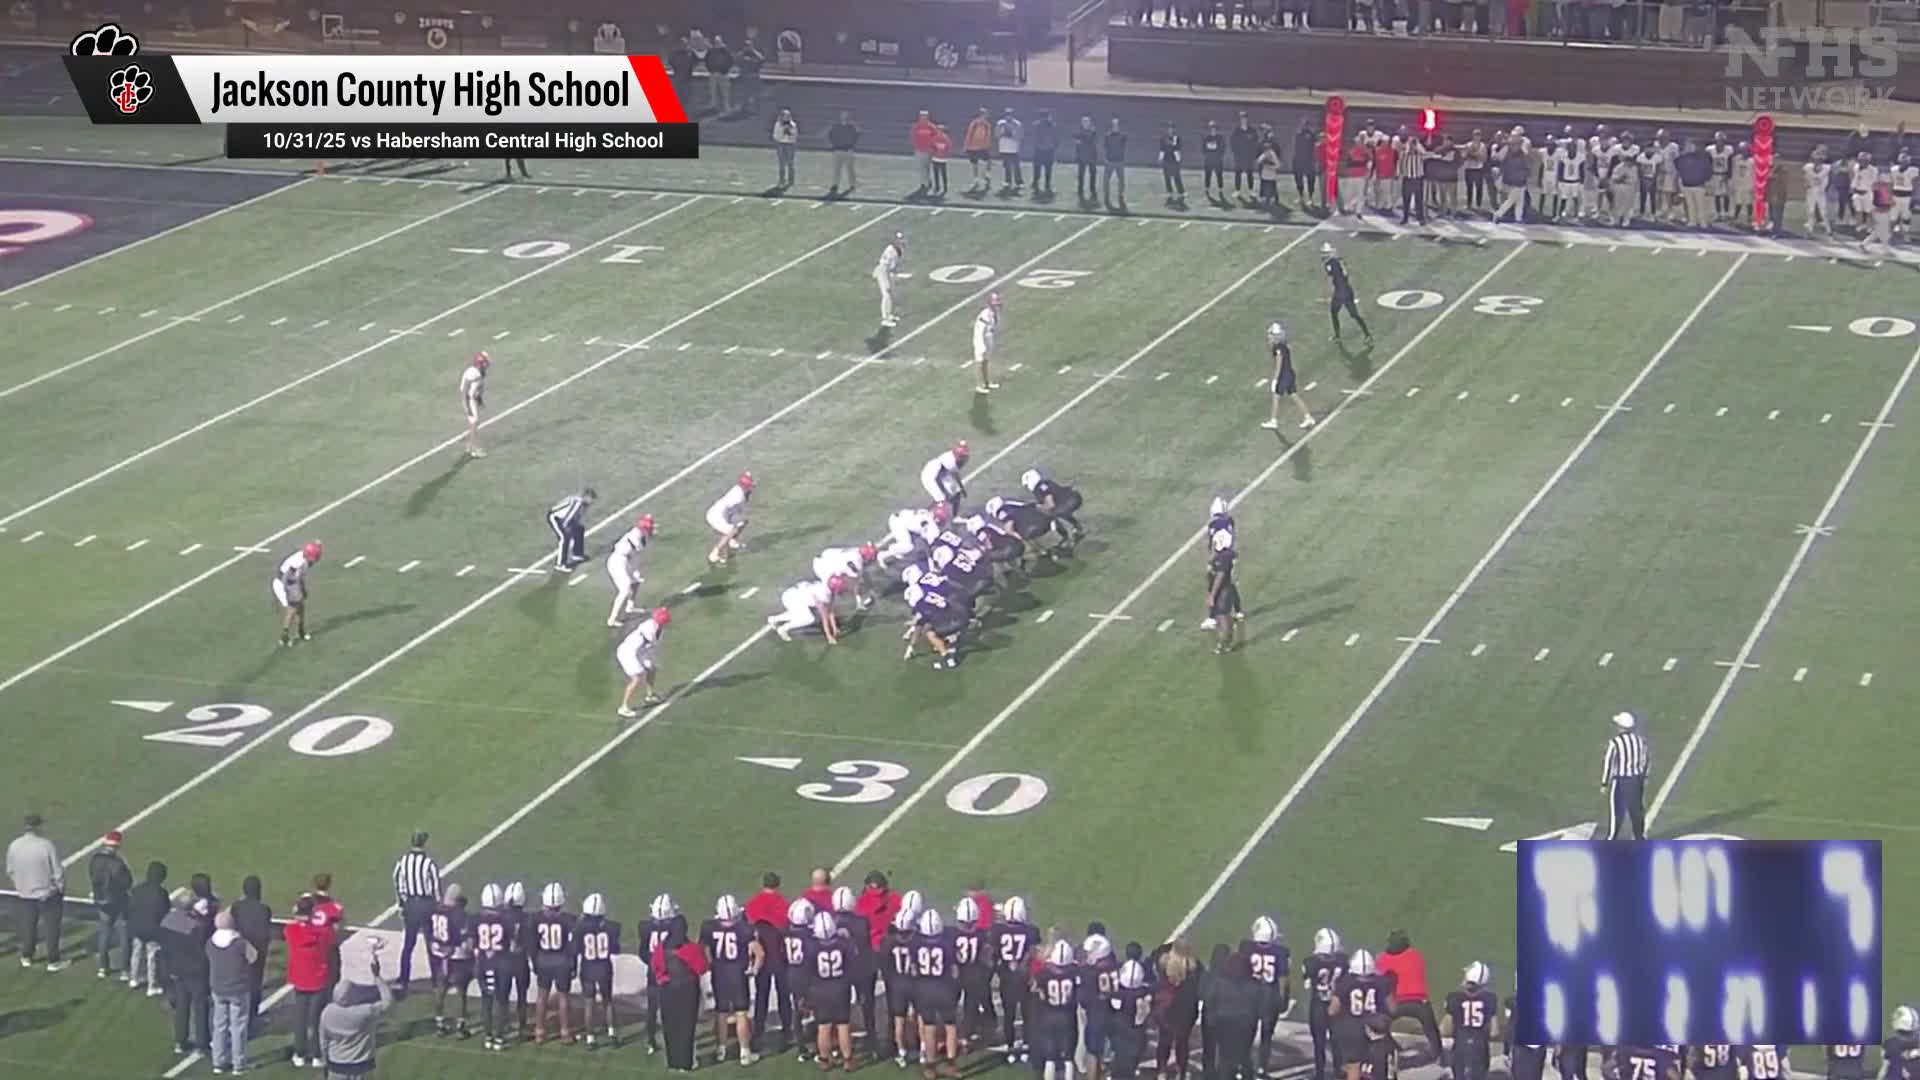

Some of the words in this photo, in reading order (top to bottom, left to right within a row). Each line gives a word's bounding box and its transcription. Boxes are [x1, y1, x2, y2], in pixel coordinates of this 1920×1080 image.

[478, 924, 504, 950] 82
[538, 924, 562, 950] 30
[583, 932, 609, 960] 80
[712, 931, 738, 960] 76
[955, 936, 978, 964] 31
[1000, 933, 1026, 961] 27
[817, 949, 843, 978] 62
[917, 947, 944, 976] 93
[1250, 954, 1276, 983] 25
[1350, 988, 1377, 1015] 64
[1461, 1001, 1484, 1027] 15
[1630, 1057, 1656, 1080] 75
[1752, 1050, 1779, 1079] 89
